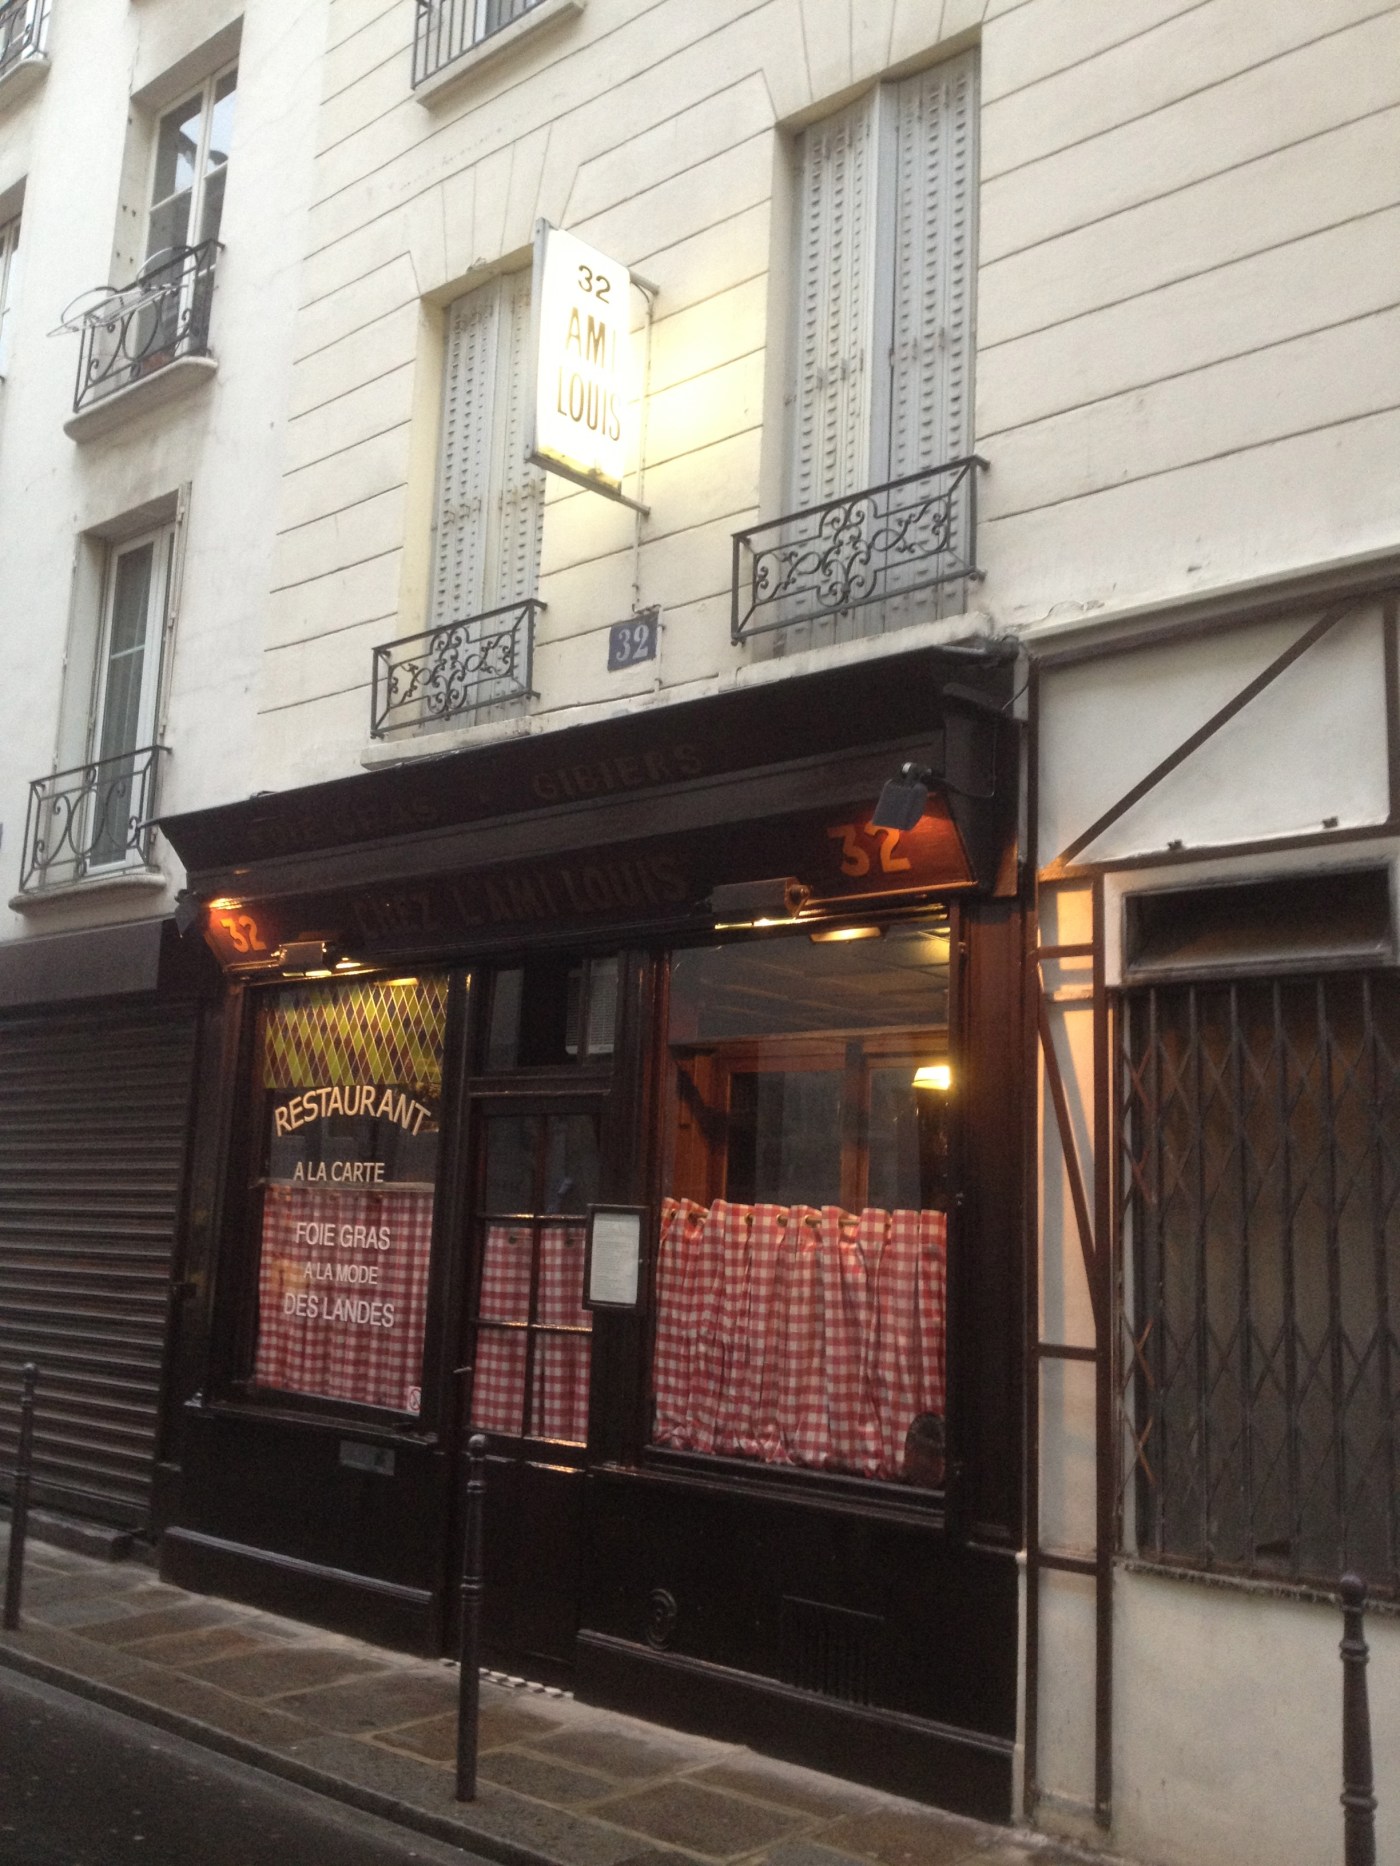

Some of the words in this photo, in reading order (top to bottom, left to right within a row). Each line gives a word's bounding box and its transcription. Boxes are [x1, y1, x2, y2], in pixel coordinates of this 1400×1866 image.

[578, 265, 611, 304] 32
[565, 306, 616, 372] AMI
[557, 366, 621, 442] LOUIS
[615, 624, 650, 662] 32
[533, 744, 701, 801] GIBIERS
[827, 821, 911, 877] 32
[560, 852, 688, 912] LOUIS
[219, 915, 267, 953] 32
[275, 1085, 431, 1137] RESTAURANT
[293, 1162, 304, 1181] A
[307, 1162, 327, 1181] LA
[331, 1162, 385, 1183] CARTE
[296, 1222, 336, 1247] FOIE
[340, 1226, 392, 1250] GRAS
[303, 1262, 314, 1279] A
[317, 1263, 333, 1281] LA
[336, 1264, 378, 1285] MODE
[284, 1293, 319, 1318] DES
[323, 1297, 395, 1328] LANDES
